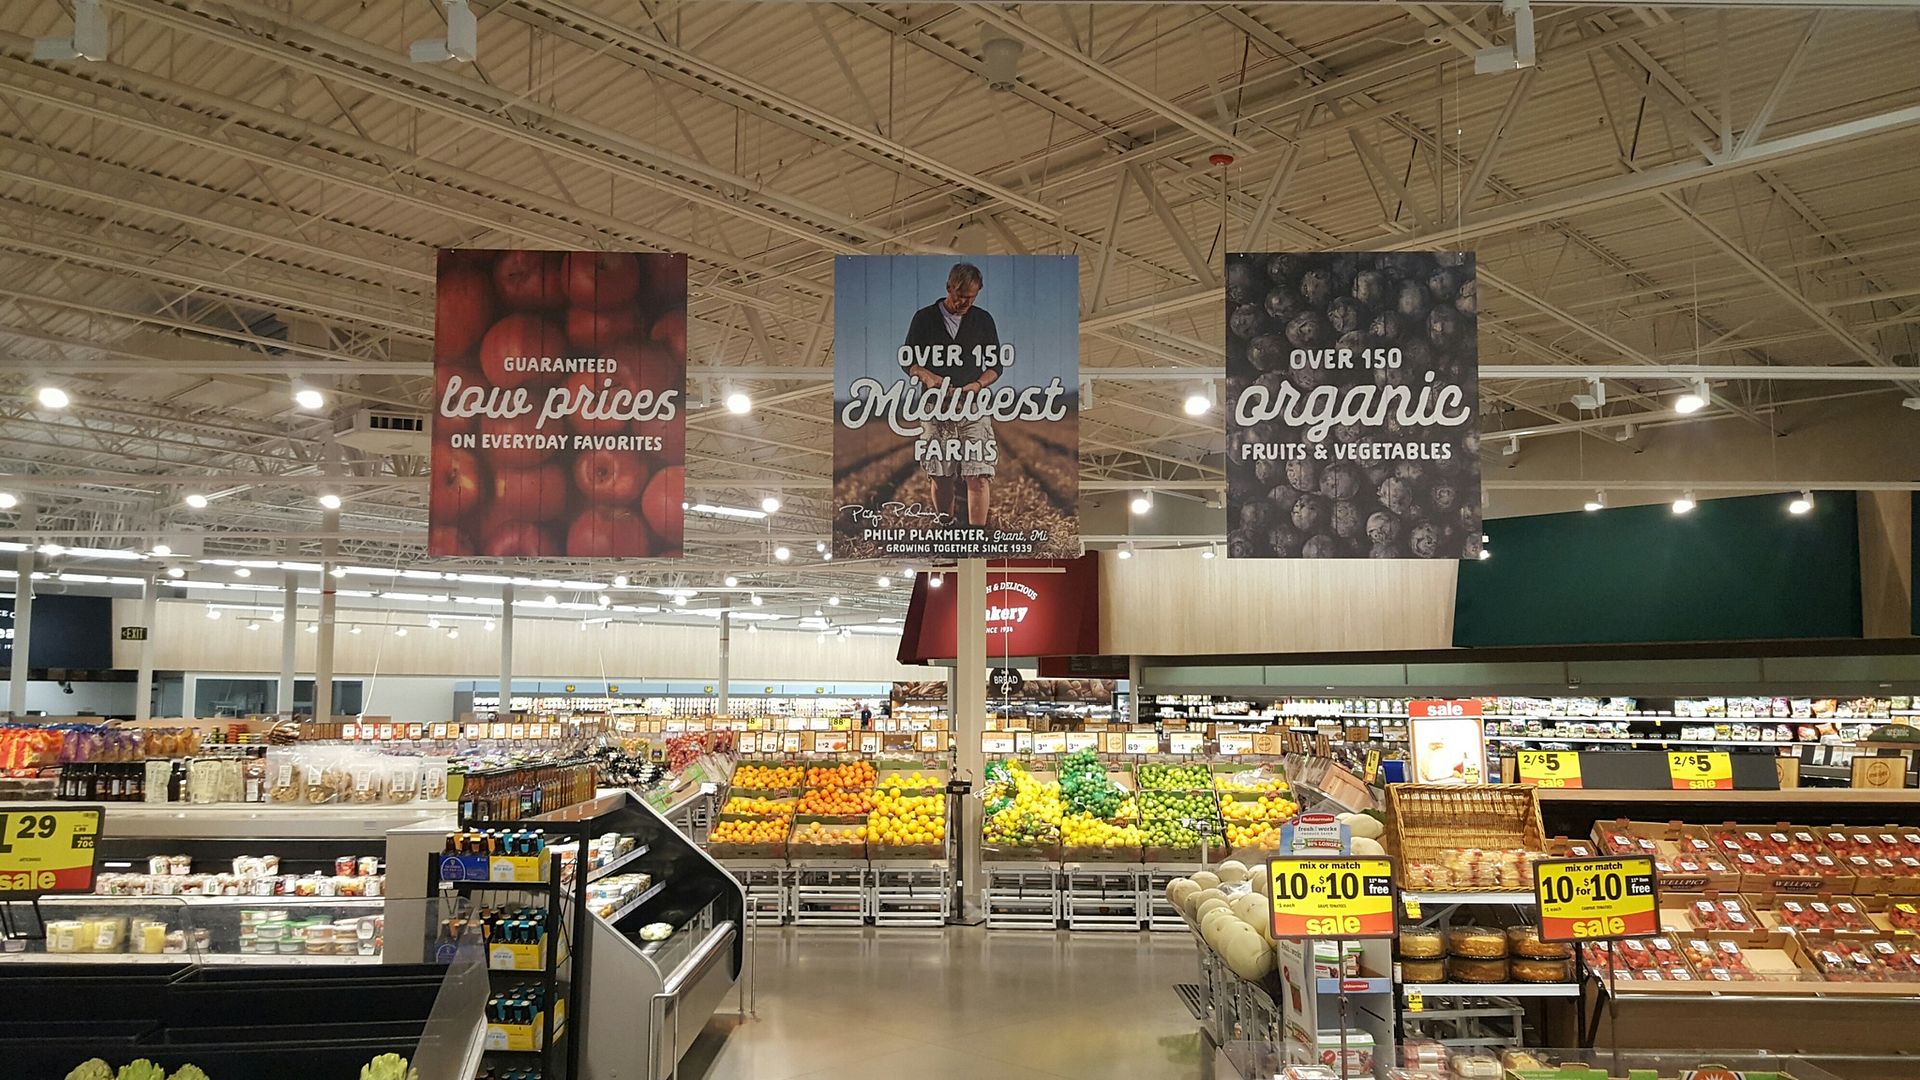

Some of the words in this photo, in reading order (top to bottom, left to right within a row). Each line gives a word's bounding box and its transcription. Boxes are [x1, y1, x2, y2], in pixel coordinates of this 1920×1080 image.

[898, 344, 963, 367] OVER
[972, 343, 1015, 367] 150
[1290, 348, 1354, 369] OVER
[1362, 348, 1402, 369] 150
[504, 357, 617, 374] GUARANTEED
[440, 376, 533, 418] low
[536, 378, 679, 430] prices
[841, 376, 1067, 436] Midwest
[1234, 370, 1471, 442] organic
[451, 434, 475, 448] ON
[482, 434, 568, 450] EVERYDAY
[574, 435, 663, 451] FAVORITES
[915, 439, 998, 462] FARMS
[1242, 443, 1306, 460] FRUITS
[1314, 444, 1328, 460] &
[1334, 442, 1452, 460] VEGETABLES
[864, 529, 906, 541] PHILIP
[910, 529, 989, 542] PLAKMEYER,
[993, 530, 1027, 542] Grant,
[886, 544, 930, 553] GROWING
[932, 544, 980, 553] TOGETHER
[984, 544, 1008, 552] SINCE
[1011, 544, 1032, 552] 1939
[993, 583, 1000, 591] &
[1000, 582, 1038, 601] DELICIOUS
[126, 628, 142, 639] EXIT
[1427, 702, 1464, 716] sale
[1524, 754, 1560, 770] 2/$5
[1674, 755, 1712, 772] 2/$5
[1538, 778, 1565, 788] sale
[1689, 780, 1716, 790] sale
[17, 815, 57, 838] 29
[1300, 861, 1316, 870] mix
[1332, 861, 1360, 870] match
[1565, 863, 1581, 872] mix
[1596, 862, 1622, 870] match
[1276, 872, 1308, 900] 10
[1310, 884, 1326, 894] for
[1369, 884, 1389, 894] free
[1542, 876, 1574, 904] 10
[1576, 887, 1591, 896] for
[1632, 884, 1650, 894] free
[1306, 915, 1360, 935] sale
[1572, 915, 1625, 938] sale
